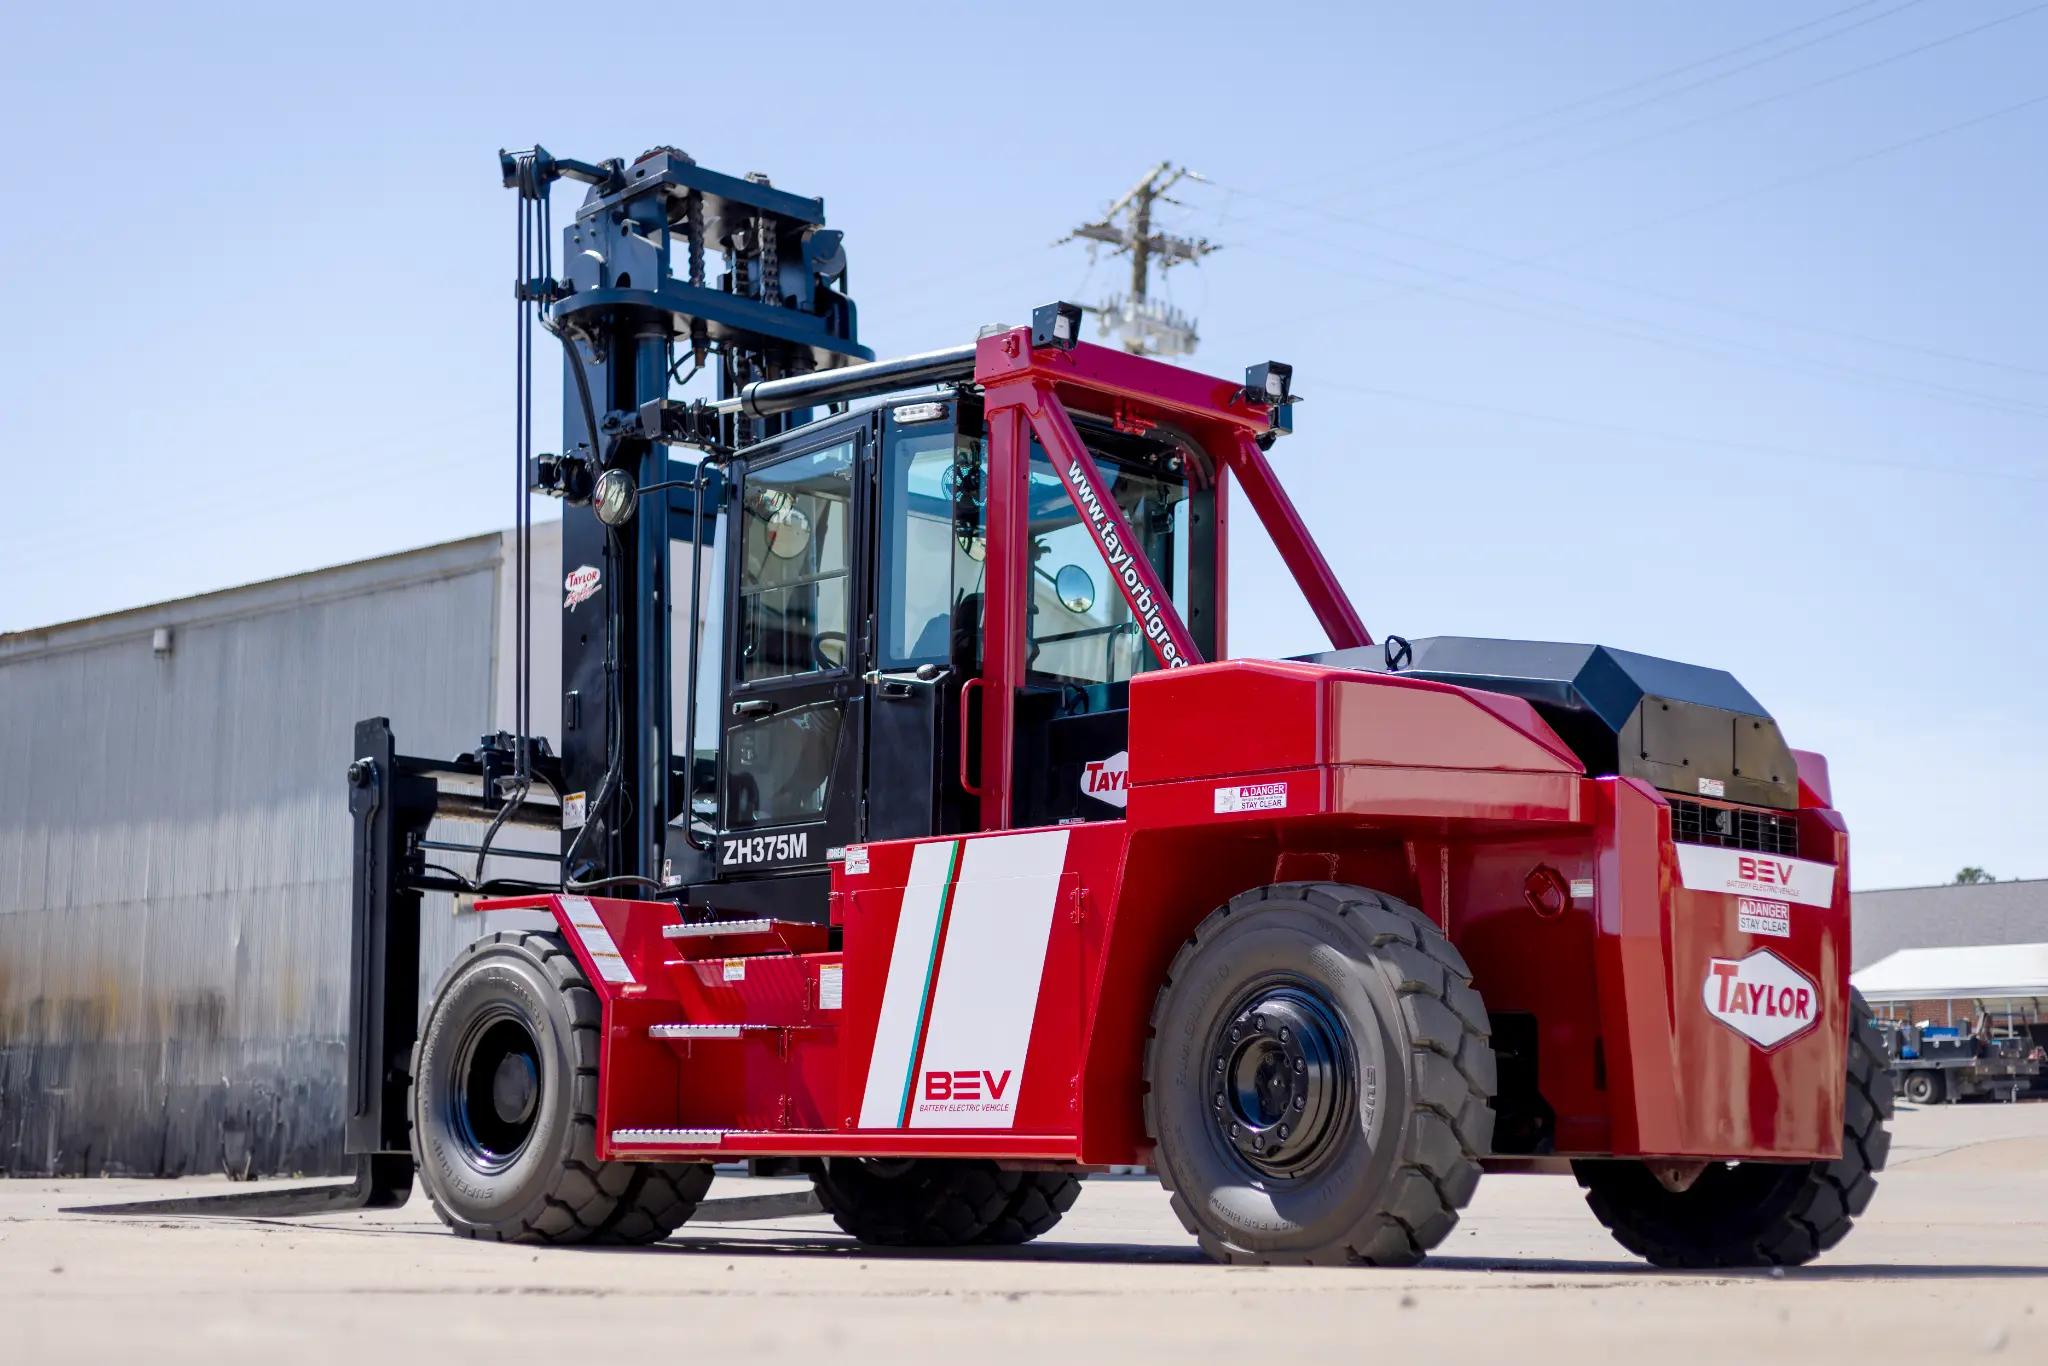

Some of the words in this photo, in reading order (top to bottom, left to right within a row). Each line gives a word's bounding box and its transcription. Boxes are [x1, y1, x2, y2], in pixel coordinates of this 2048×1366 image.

[568, 570, 597, 587] TAYLOR
[1250, 784, 1285, 796] DANGER
[1241, 801, 1258, 810] STAY
[1259, 799, 1282, 808] CLEAR
[723, 832, 807, 865] ZH375M
[1738, 856, 1794, 886] BEV
[1726, 879, 1751, 889] BATTERY
[1779, 886, 1801, 897] VEHICLE
[1749, 901, 1788, 919] DANGER
[1740, 917, 1760, 930] STAY
[1762, 920, 1788, 934] CLEAR
[1713, 962, 1810, 1020] TAYLOR
[925, 1070, 1012, 1101] BEV
[919, 1104, 948, 1112] BATTERY
[949, 1104, 980, 1112] ELECTRIC
[981, 1103, 1010, 1112] VEHICLE
